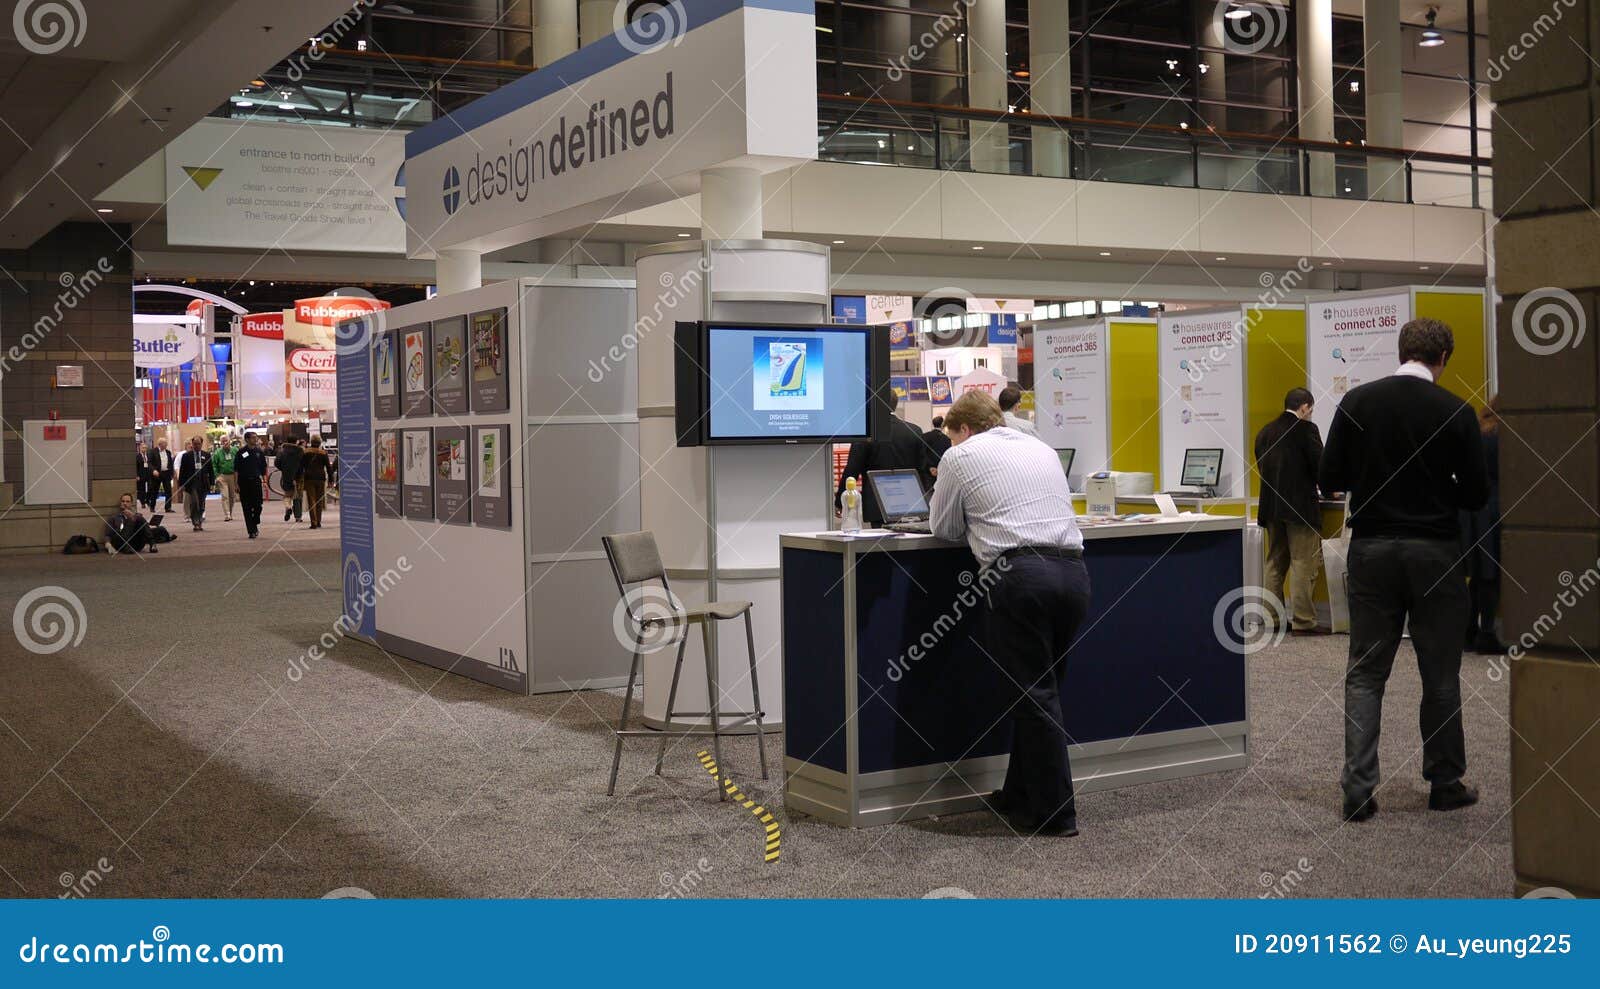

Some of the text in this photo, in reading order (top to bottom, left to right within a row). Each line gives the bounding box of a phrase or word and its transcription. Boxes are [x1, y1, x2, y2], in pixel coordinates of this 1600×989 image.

[240, 148, 375, 166] entrance to north building
[242, 183, 266, 192] clean
[276, 184, 308, 193] contain
[244, 211, 262, 220] The
[1334, 304, 1397, 318] housewares
[1180, 321, 1232, 333] housewares
[1334, 316, 1397, 331] connect 365
[1053, 331, 1097, 343] housewares
[1181, 331, 1232, 344] connect 365
[1054, 341, 1097, 354] connect 365
